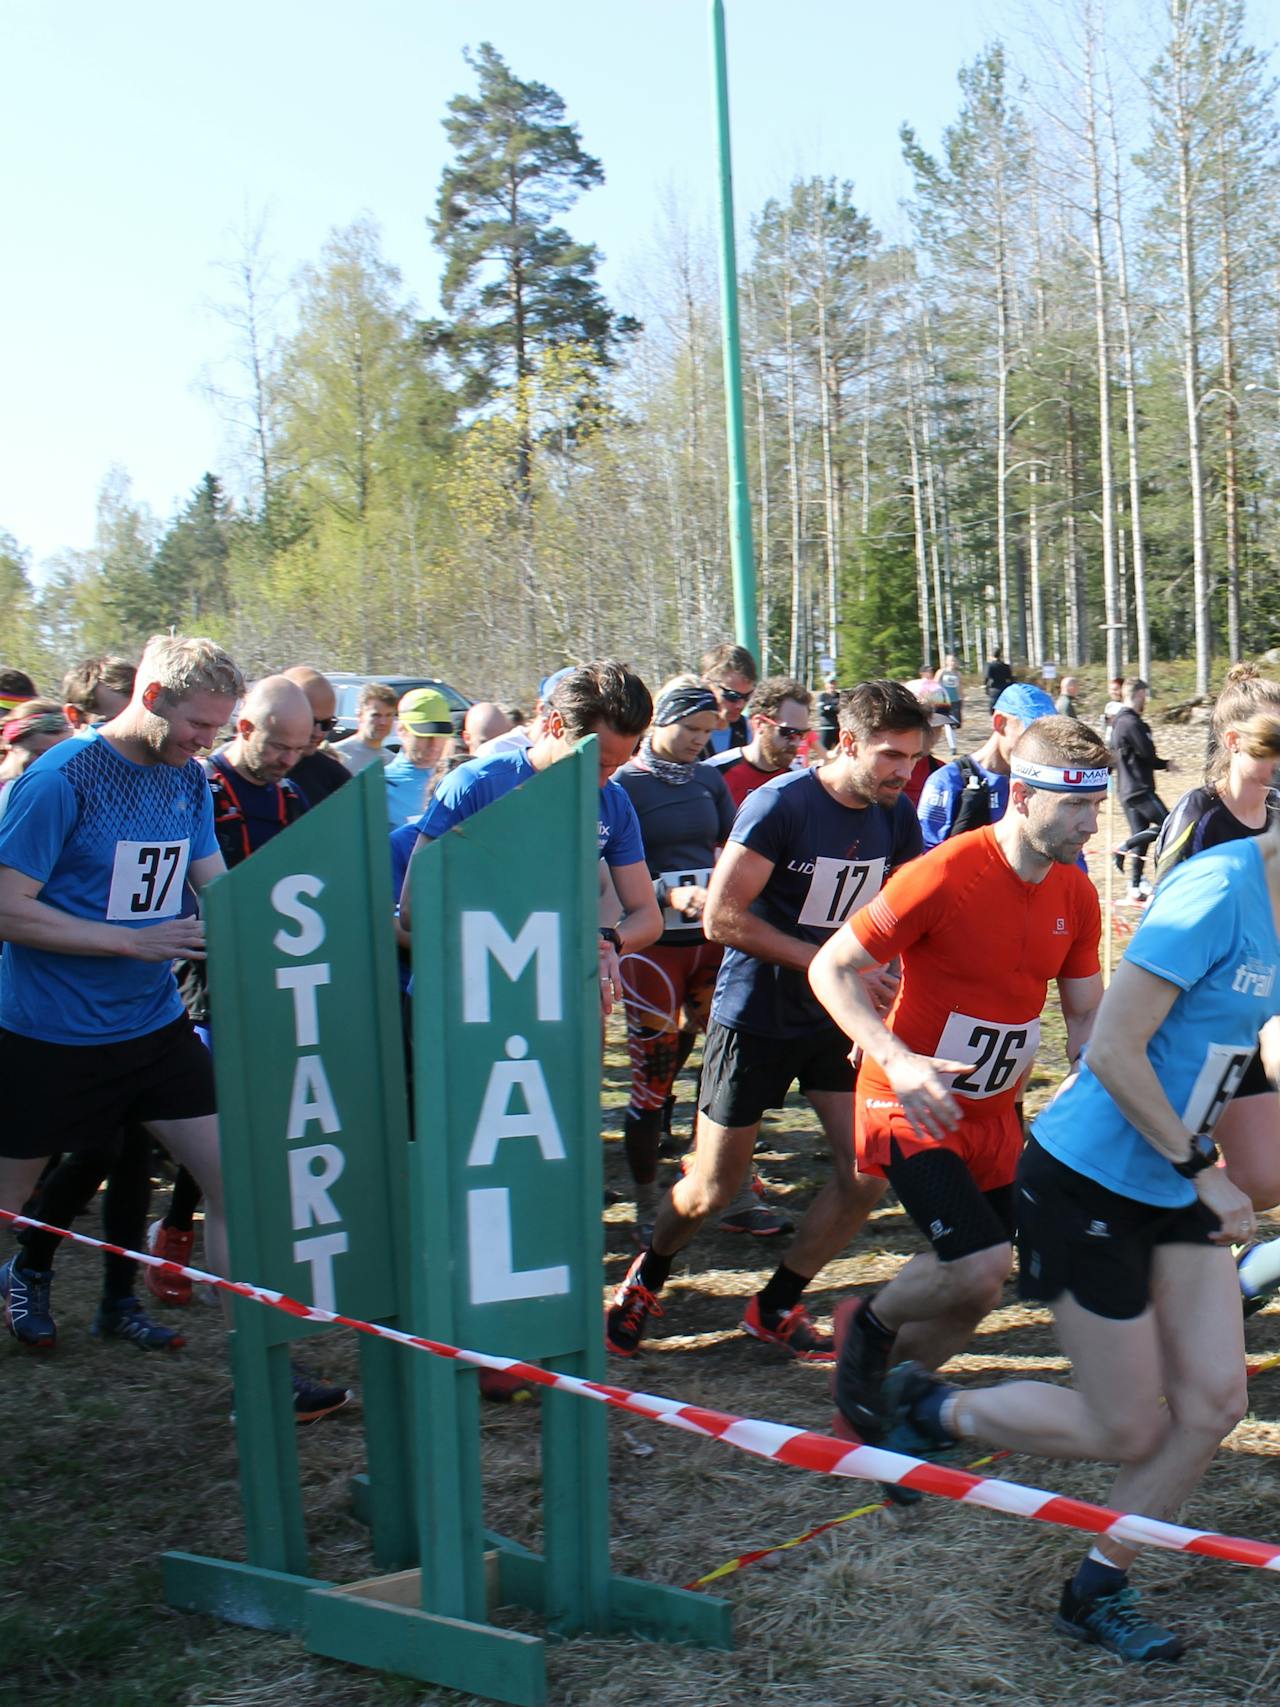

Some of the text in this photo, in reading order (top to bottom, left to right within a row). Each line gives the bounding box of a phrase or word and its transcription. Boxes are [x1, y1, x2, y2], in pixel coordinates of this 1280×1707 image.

[131, 847, 181, 912] 37
[826, 865, 870, 921] 17
[951, 1026, 1028, 1092] 26
[270, 874, 349, 1316] START
[461, 911, 570, 1305] MÅL
